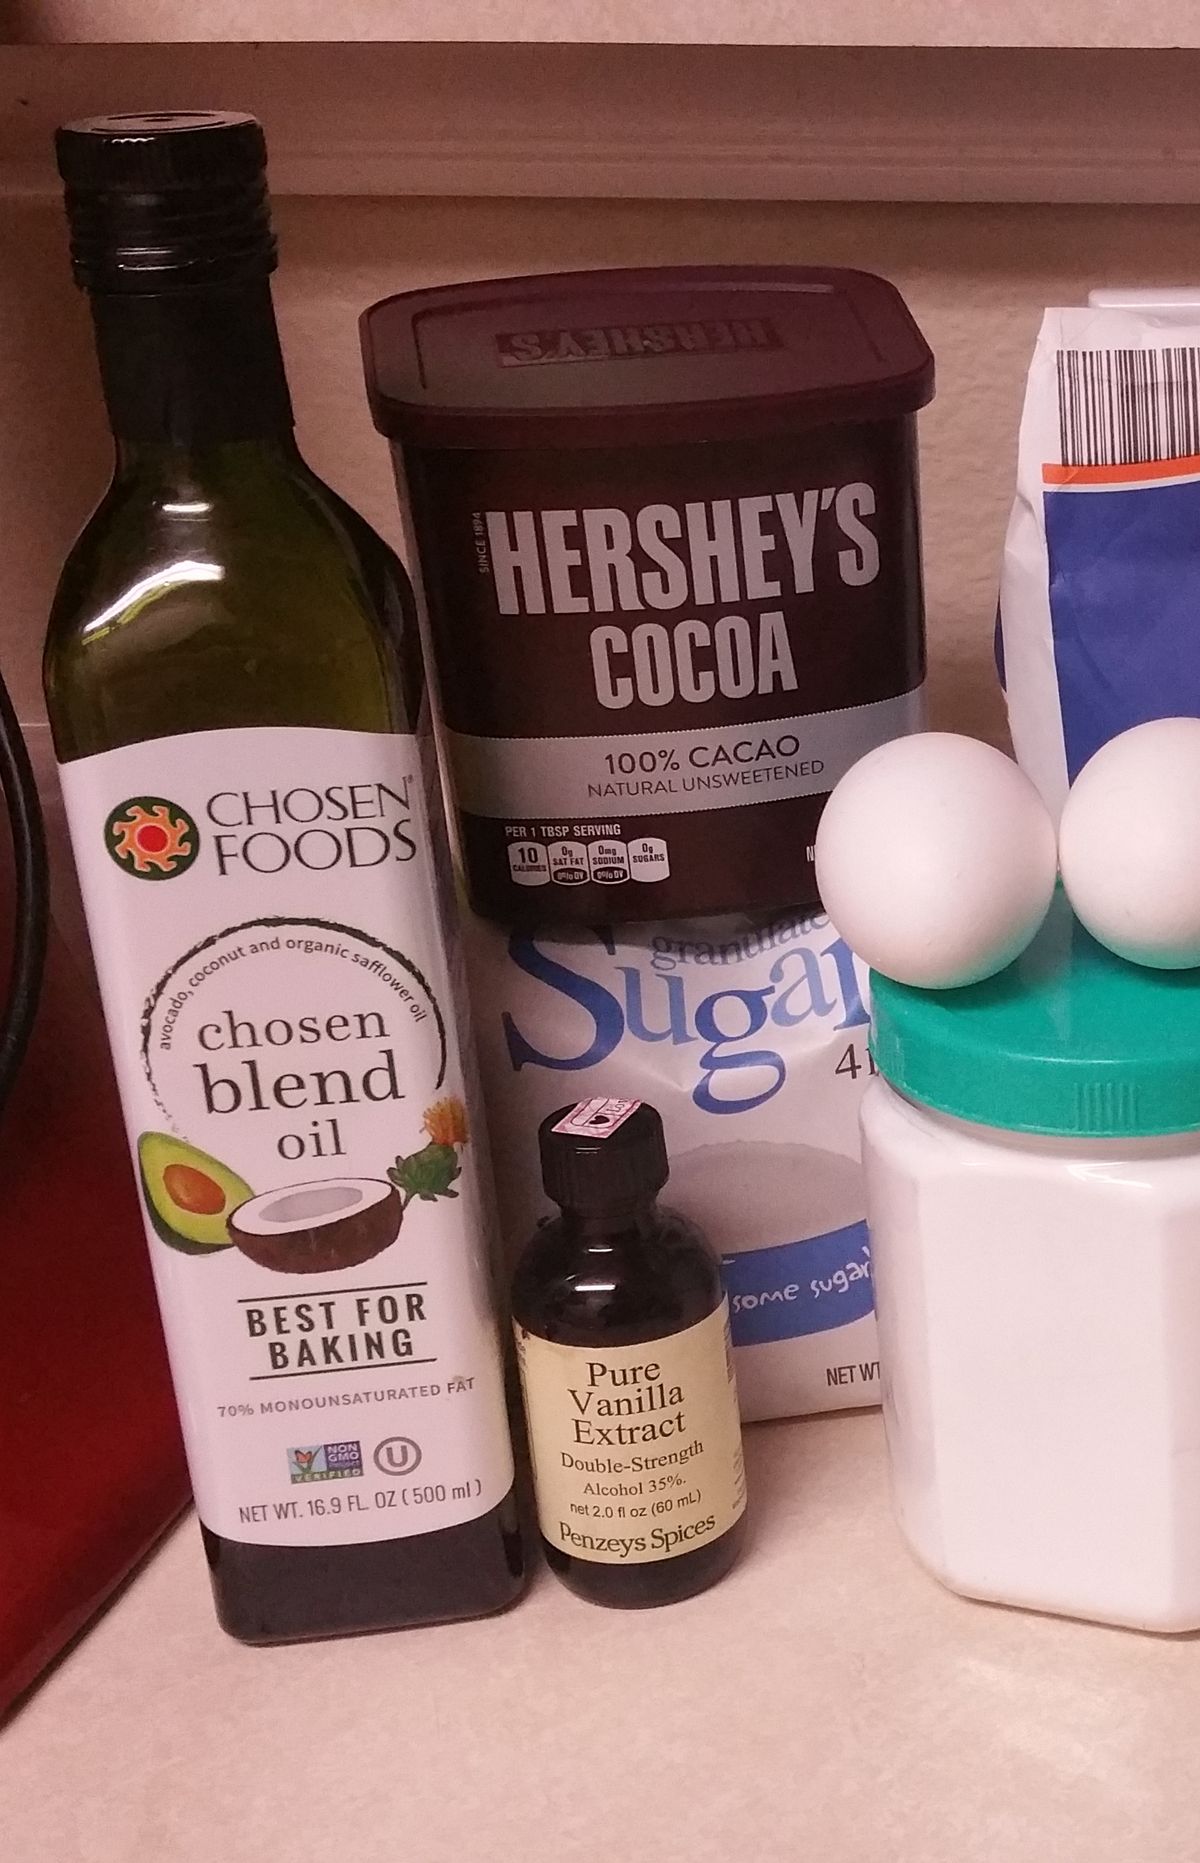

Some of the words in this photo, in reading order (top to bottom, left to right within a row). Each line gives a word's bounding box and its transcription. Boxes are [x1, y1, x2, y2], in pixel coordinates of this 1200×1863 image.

[472, 511, 485, 536] 1894
[476, 539, 490, 574] SINCE
[484, 482, 880, 615] HERSHEY'S
[588, 611, 799, 710] COCOA
[604, 748, 680, 775] 100%
[688, 735, 800, 768] CACAO
[588, 779, 678, 798] NATURAL
[682, 760, 825, 792] UNSWEETENED
[206, 776, 409, 828] CHOSEN
[212, 818, 417, 877] FOODS
[505, 826, 527, 838] PER
[531, 827, 537, 838] 1
[540, 825, 570, 838] TBSP
[573, 824, 622, 837] SERVING
[641, 843, 654, 854] 0g
[518, 847, 539, 864] 10
[553, 858, 569, 866] SAT
[570, 857, 584, 866] FAT
[561, 846, 574, 858] 0g
[592, 856, 625, 866] SODIUM
[598, 845, 617, 856] 0mg
[632, 854, 665, 864] SUGARS
[650, 914, 832, 971] granulate
[160, 990, 194, 1050] avocado,
[188, 946, 246, 988] coconut
[249, 937, 281, 955] and
[286, 938, 349, 959] organic
[351, 953, 415, 1004] safflower
[410, 1002, 427, 1022] oil
[197, 1010, 391, 1051] chosen
[193, 1049, 405, 1114] blend
[277, 1119, 347, 1160] oil
[246, 1301, 336, 1338] BEST
[356, 1293, 427, 1327] FOR
[731, 1282, 800, 1316] some
[268, 1328, 414, 1370] BAKING
[585, 1361, 661, 1388] Pure
[826, 1364, 857, 1387] NET
[217, 1404, 255, 1418] 70%
[260, 1384, 441, 1415] MONOUNSATURATED
[447, 1377, 476, 1394] FAT
[567, 1383, 685, 1417] Vanilla
[571, 1410, 687, 1446] Extract
[327, 1443, 358, 1454] NON
[328, 1451, 359, 1462] GMO
[560, 1439, 705, 1474] Double-Strength
[583, 1482, 643, 1497] Alcohol
[648, 1473, 687, 1493] 35%.
[239, 1504, 268, 1524] NET
[273, 1500, 304, 1520] WT.
[308, 1497, 341, 1517] 16.9
[375, 1489, 398, 1509] OZ
[570, 1502, 590, 1517] net
[593, 1504, 614, 1519] 2.0
[618, 1506, 625, 1519] fl
[630, 1507, 648, 1518] oz
[651, 1498, 674, 1517] (60
[677, 1488, 702, 1510] mL)
[559, 1521, 647, 1558] Penzeys
[651, 1514, 716, 1553] Spices
